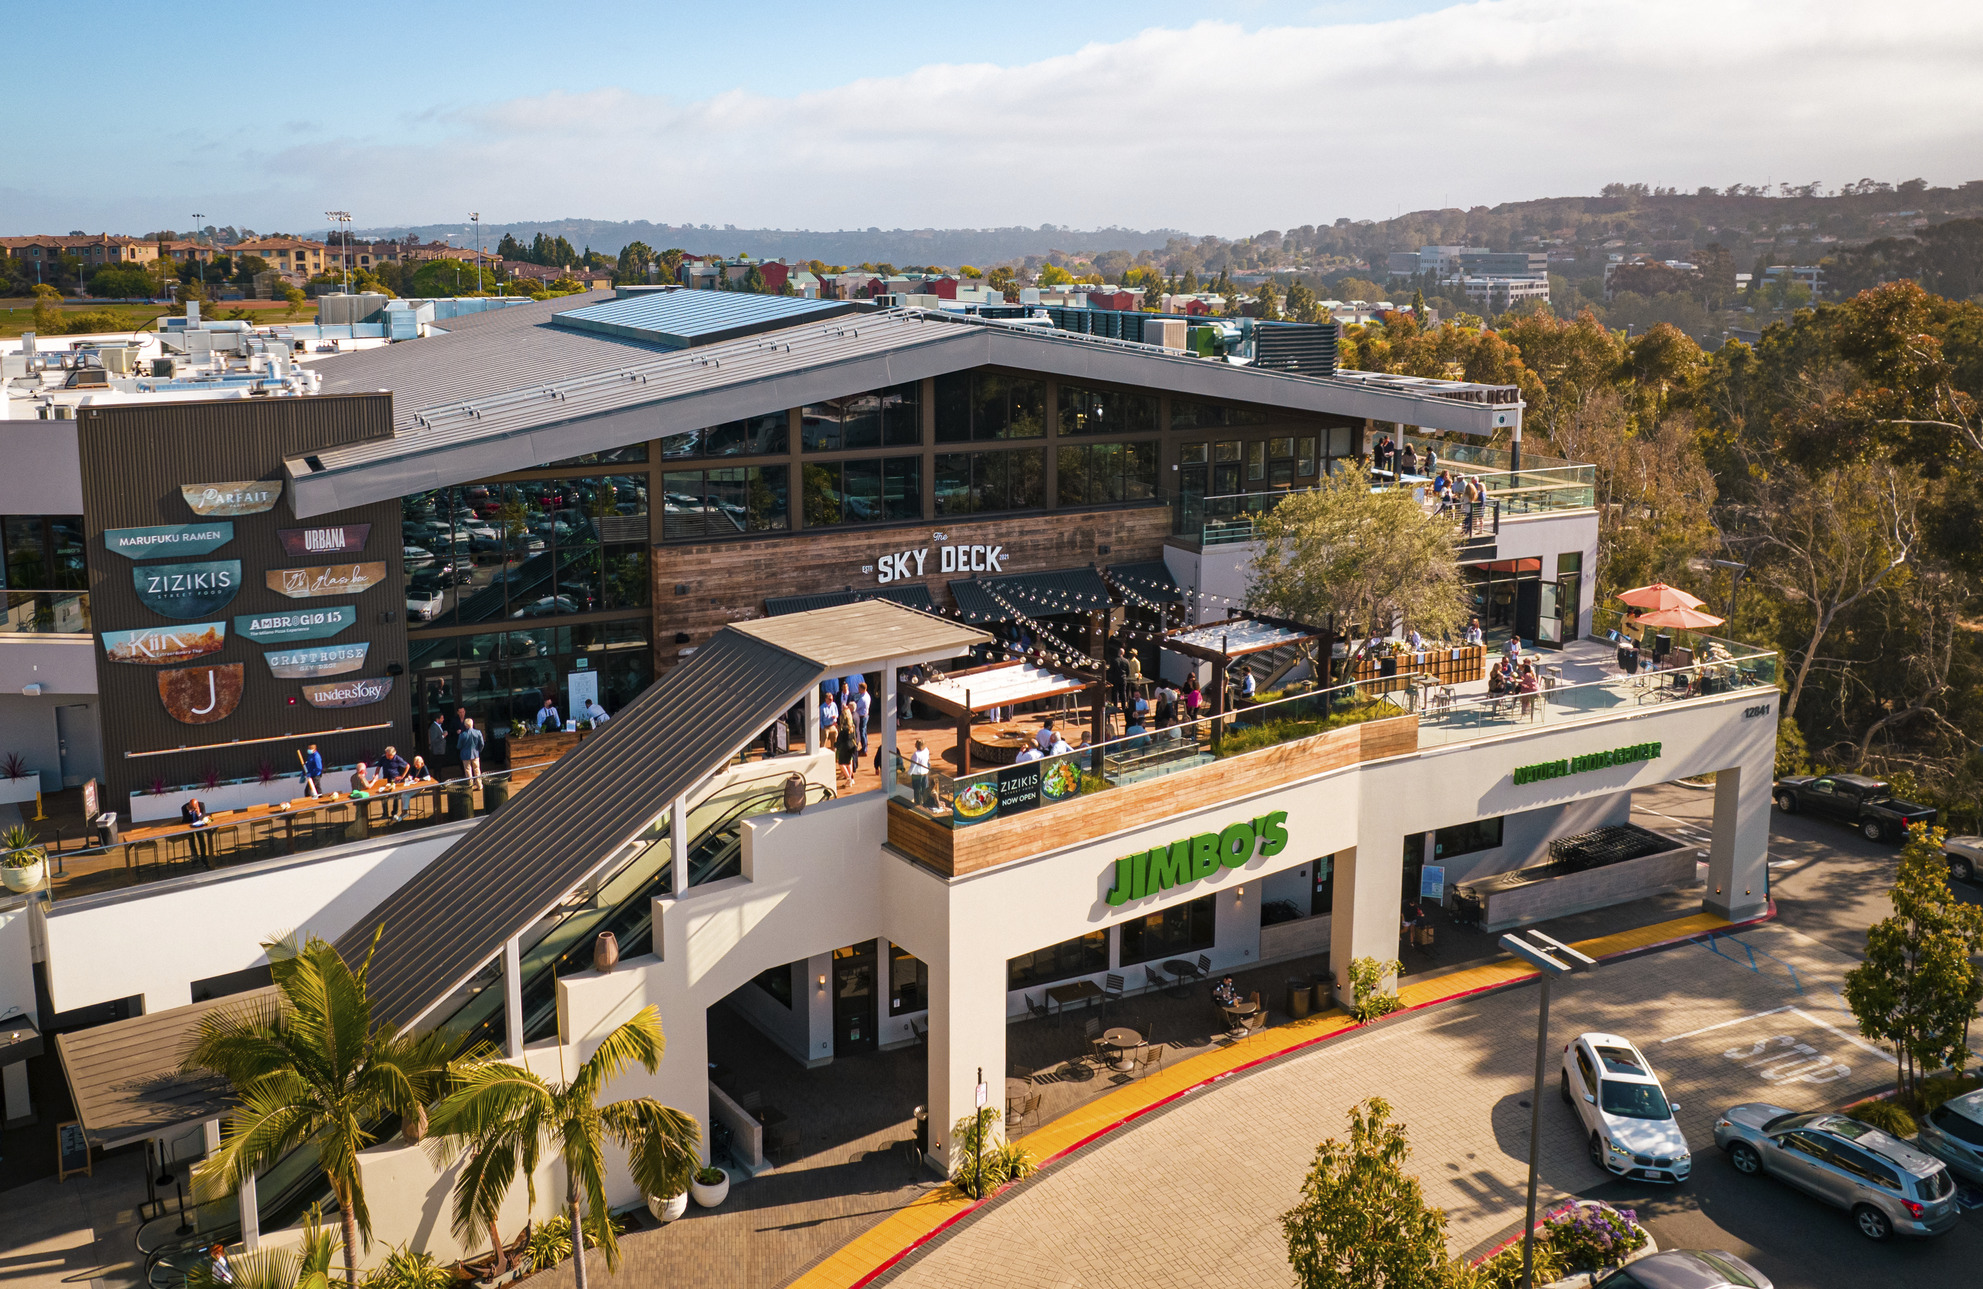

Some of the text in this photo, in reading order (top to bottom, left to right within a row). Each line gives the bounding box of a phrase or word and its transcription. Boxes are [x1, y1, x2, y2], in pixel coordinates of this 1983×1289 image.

[198, 488, 268, 508] PARFAIT
[119, 531, 221, 546] MARUFUKU RAMEN
[304, 528, 345, 550] URBANA
[932, 531, 949, 542] The
[877, 547, 929, 584] SKY
[940, 545, 1003, 573] DECK
[147, 571, 231, 593] ZIZIKIS
[197, 589, 222, 597] FOOD
[326, 611, 342, 623] 15
[128, 631, 188, 658] Kiin
[270, 648, 364, 667] CRAFTHOUSE
[191, 670, 216, 715] J
[1744, 704, 1770, 718] 12841
[1513, 741, 1662, 785] NATURAL FOODS GROCER
[1000, 774, 1038, 793] ZIZIKIS
[1001, 792, 1037, 807] NOW OPEN
[1105, 810, 1289, 907] JIMBO'S
[1723, 1035, 1852, 1086] STOP
